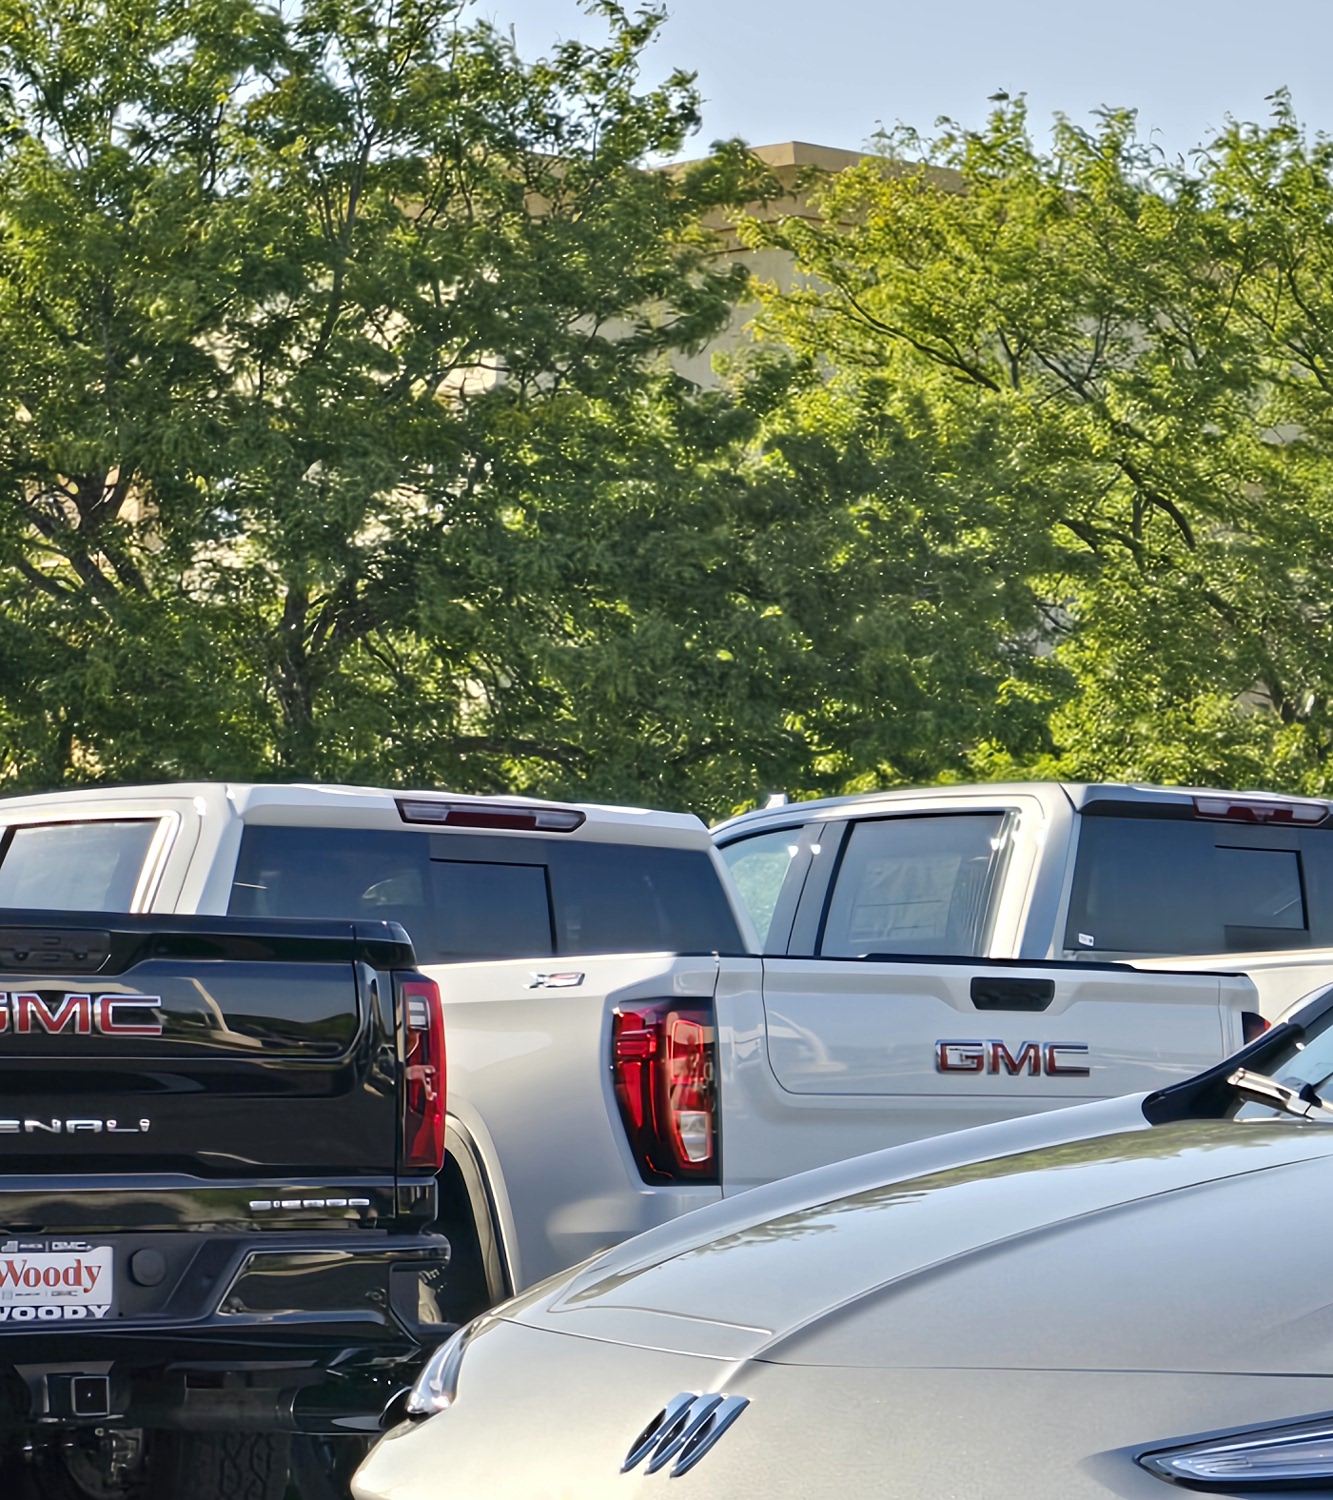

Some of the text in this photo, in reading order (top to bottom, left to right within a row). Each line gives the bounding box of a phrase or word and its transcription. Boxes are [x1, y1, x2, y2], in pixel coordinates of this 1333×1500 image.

[0, 993, 162, 1035] MC
[935, 1039, 1090, 1076] GMC
[0, 1258, 102, 1293] Woody
